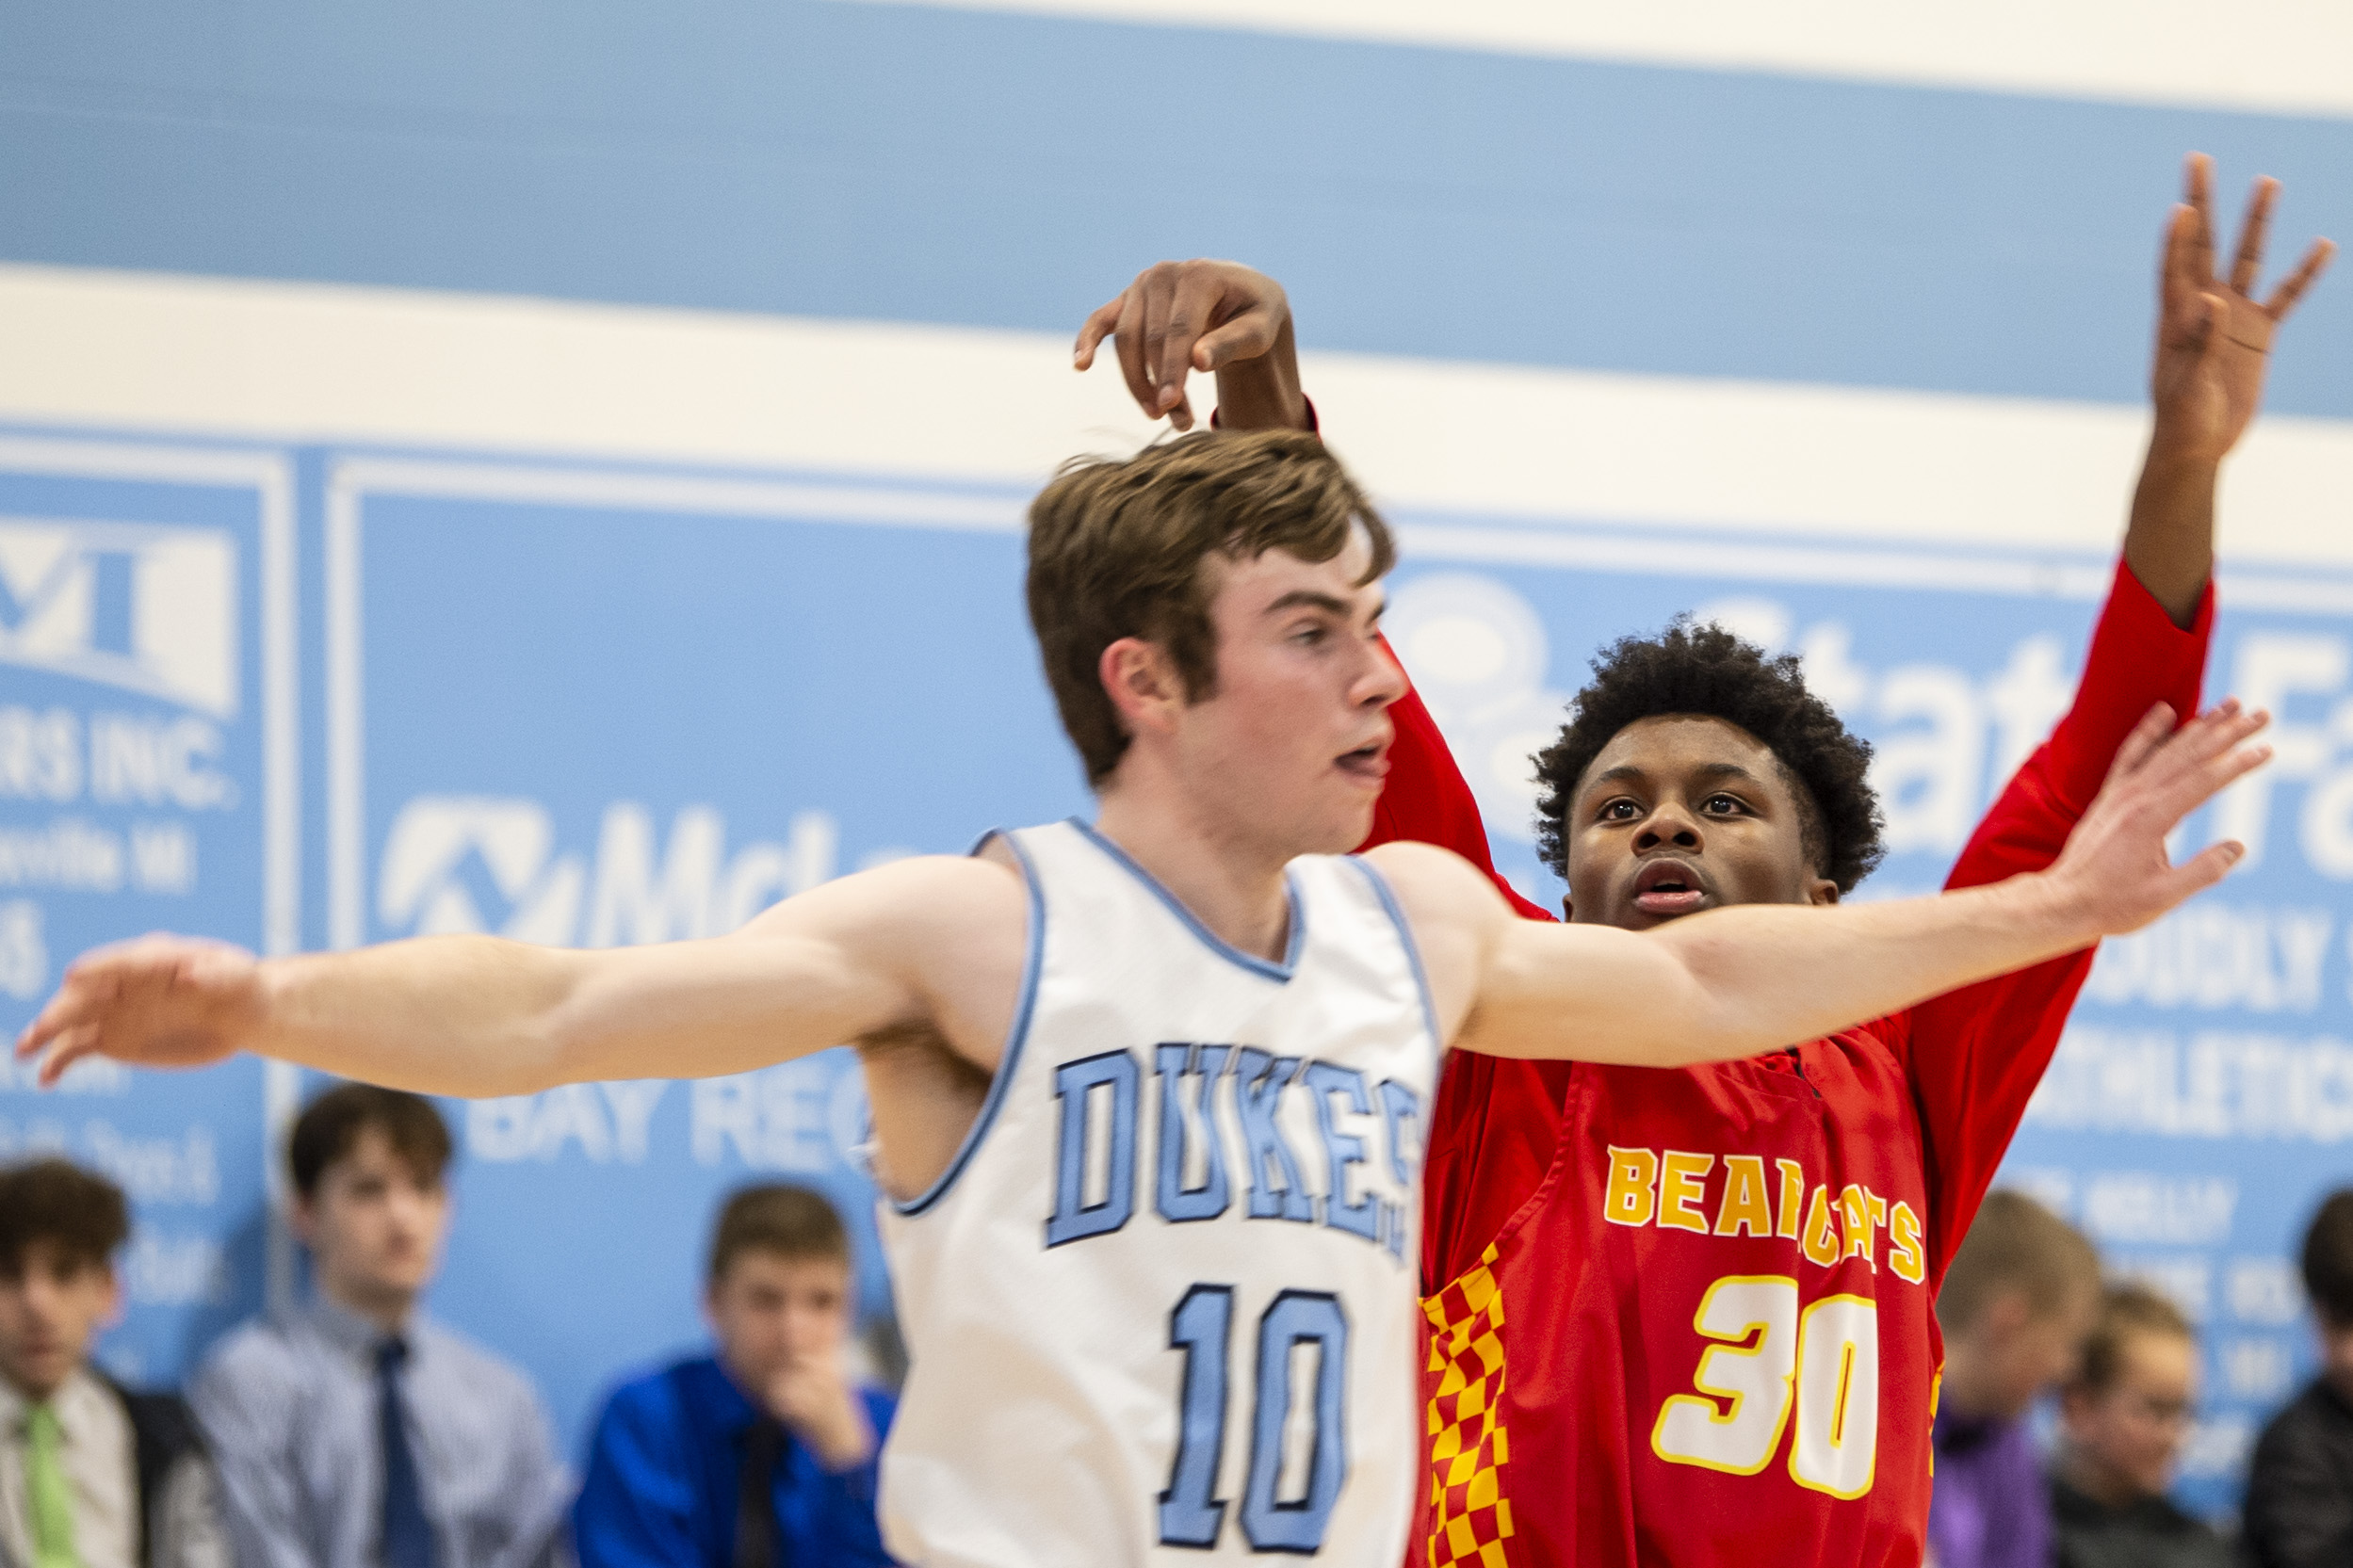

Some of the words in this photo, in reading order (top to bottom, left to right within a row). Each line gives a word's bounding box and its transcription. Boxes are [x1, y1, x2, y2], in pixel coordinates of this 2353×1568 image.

[2023, 1022, 2353, 1143] ATHLETIC
[1603, 1143, 1925, 1285] BEARCATS
[1155, 1282, 1352, 1556] 10
[1650, 1274, 1880, 1501] 30
